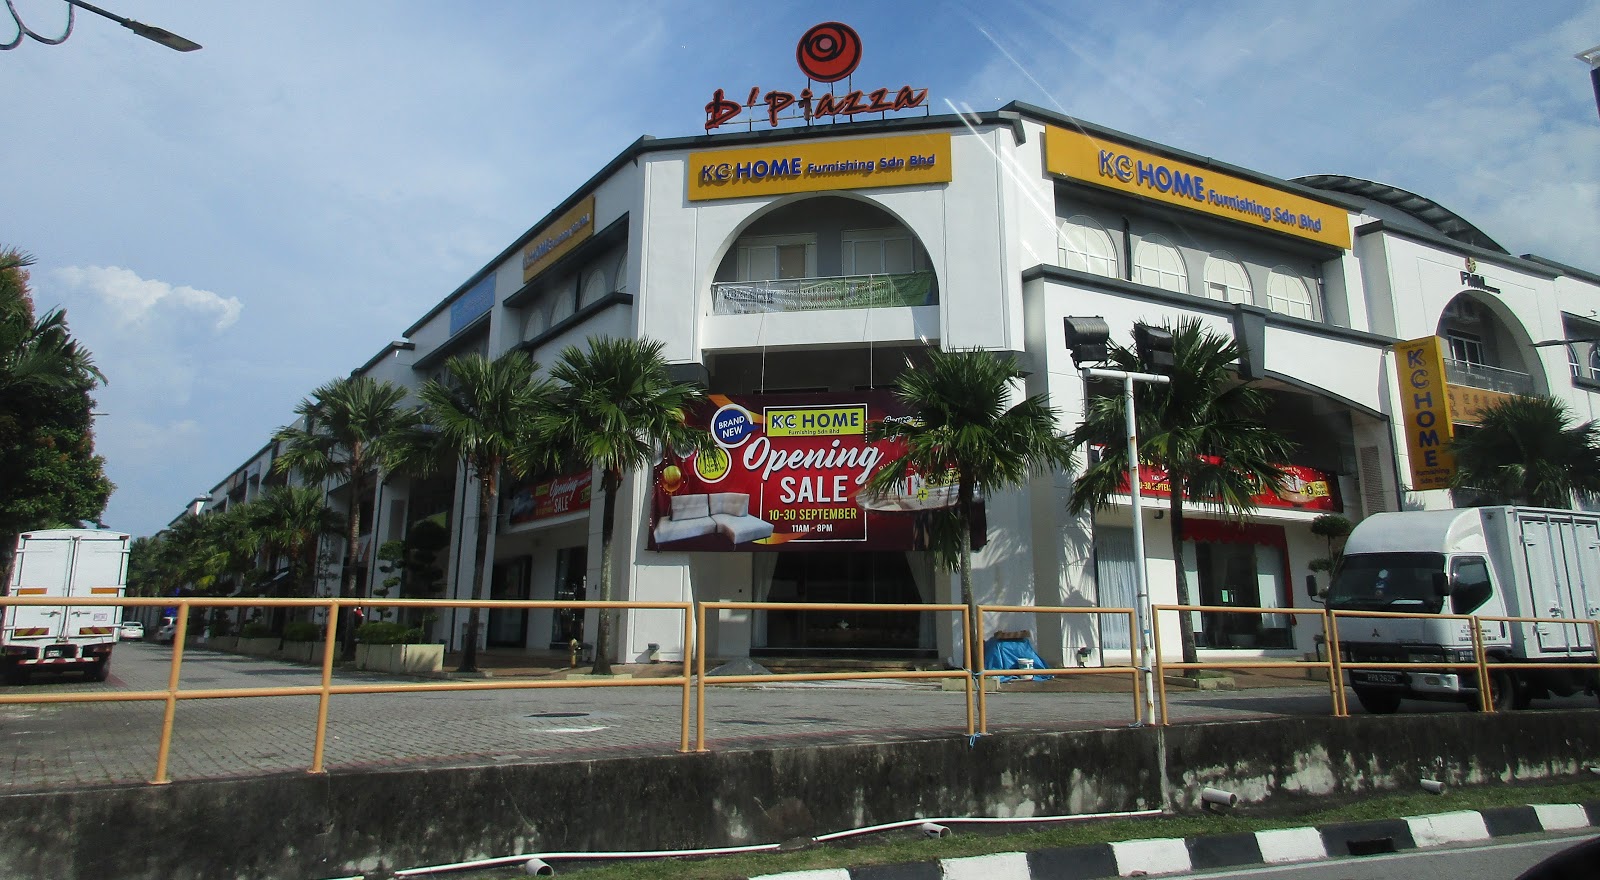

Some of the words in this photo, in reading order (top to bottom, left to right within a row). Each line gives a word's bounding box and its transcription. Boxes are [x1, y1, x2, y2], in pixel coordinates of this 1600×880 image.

[701, 163, 734, 182] KC
[736, 158, 803, 180] HOME
[807, 159, 876, 175] Furnishing
[879, 157, 905, 169] Sdn
[909, 154, 935, 166] Bhd
[1099, 149, 1134, 183] KC
[1136, 160, 1206, 202] HOME
[1207, 189, 1272, 221] Furnishing
[1273, 206, 1297, 225] Sdn
[1299, 213, 1322, 233] Bhd
[718, 415, 745, 430] BRAND
[771, 414, 797, 429] KC
[802, 412, 859, 428] HOME
[722, 425, 743, 439] NEW
[743, 436, 884, 485] Opening
[780, 475, 848, 504] SALE
[553, 495, 570, 513] SALE
[769, 509, 797, 521] 10-30
[799, 507, 857, 520] SEPTEMBER
[791, 524, 810, 533] 11AM
[817, 524, 833, 533] 8PM
